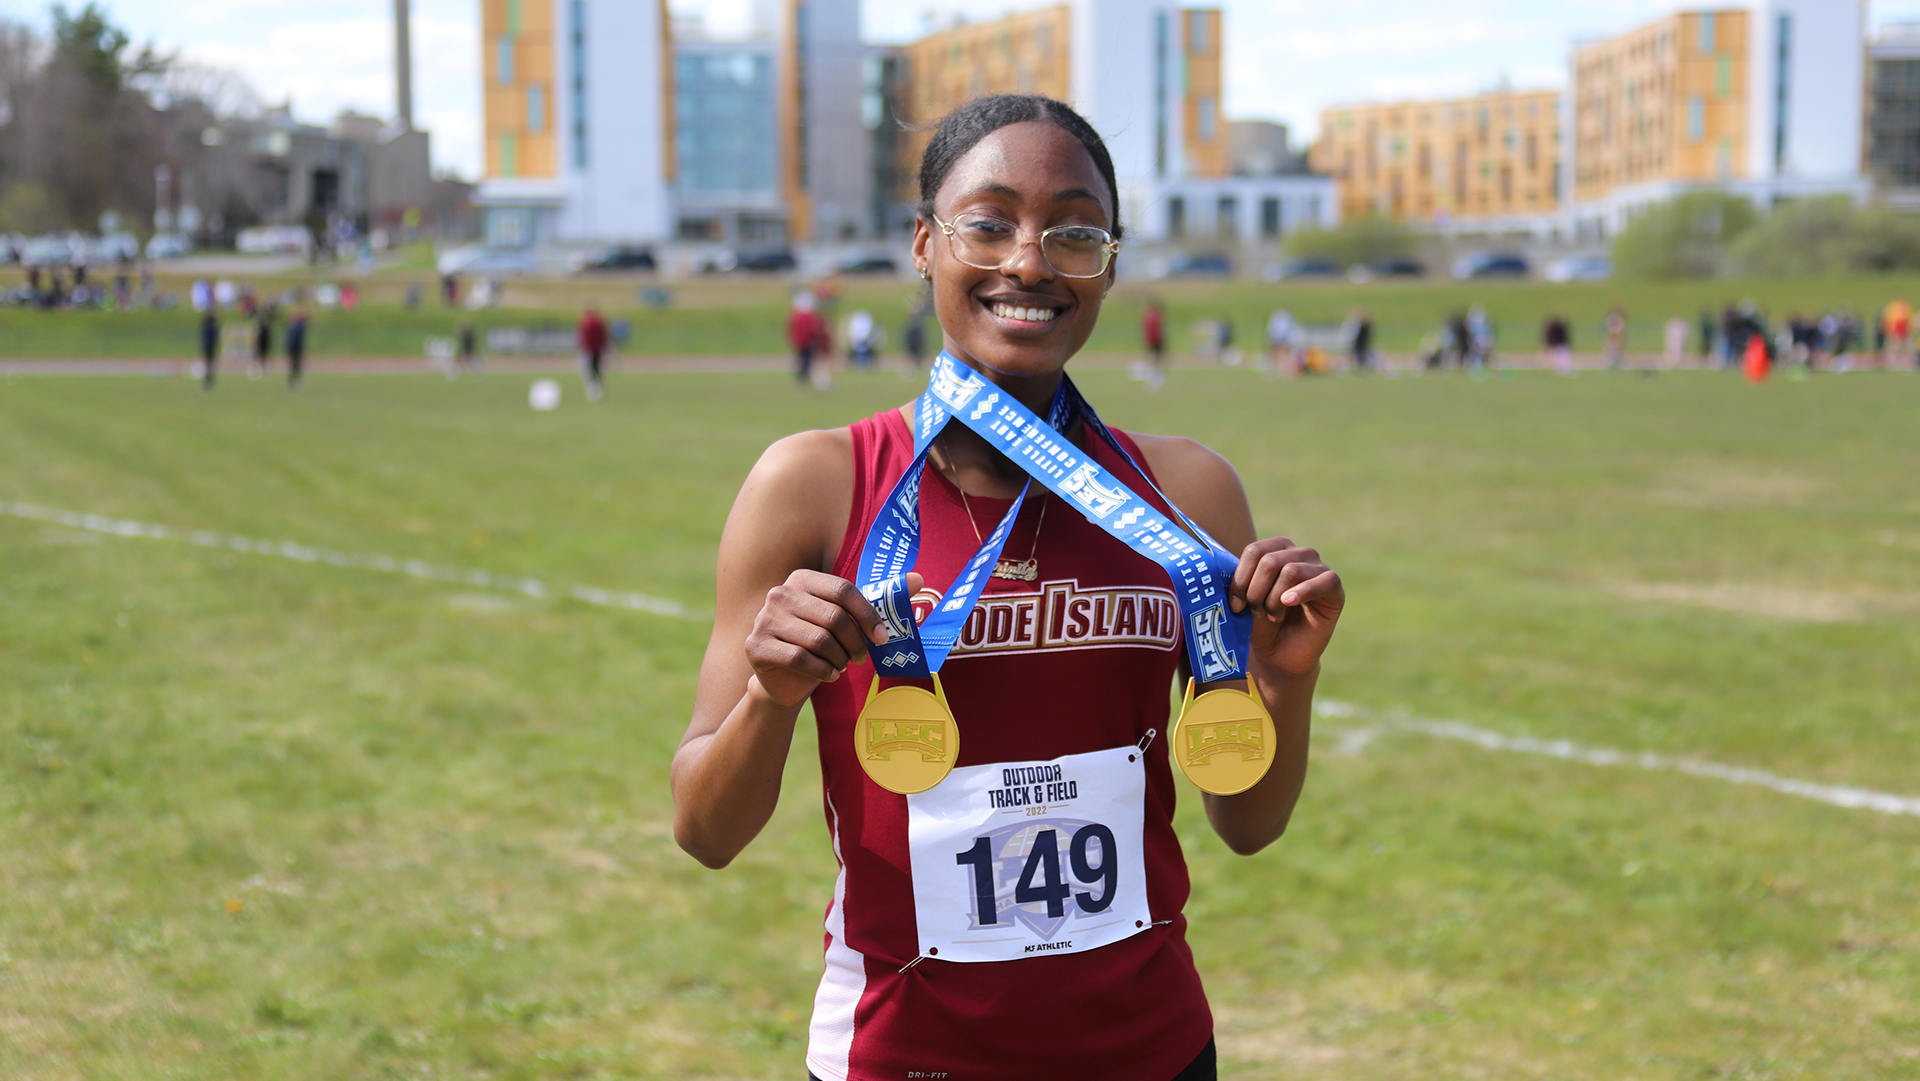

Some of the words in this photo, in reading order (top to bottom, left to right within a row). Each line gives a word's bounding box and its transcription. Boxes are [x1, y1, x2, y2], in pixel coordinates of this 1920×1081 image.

[990, 421, 1023, 447] EAST
[998, 405, 1077, 468] CONFERENCE
[1022, 445, 1064, 479] LITTLE
[1064, 473, 1120, 515] LEC
[1133, 530, 1169, 554] EAST
[869, 552, 888, 582] LITTLE
[1143, 519, 1216, 598] CONFERENCE
[1168, 553, 1201, 604] LITTLE
[1048, 588, 1179, 644] ISLAND
[1194, 608, 1229, 678] LEC
[870, 722, 942, 751] LEC
[1189, 722, 1261, 752] LEC
[1002, 764, 1062, 787] OUTDOOR
[988, 786, 1031, 809] TRACK
[1034, 785, 1043, 804] &
[1046, 780, 1078, 803] FIELD
[1025, 805, 1047, 817] 2022
[956, 823, 1118, 926] 149
[1037, 940, 1072, 951] ATHLETIC
[907, 1071, 948, 1079] DRI-FIT
